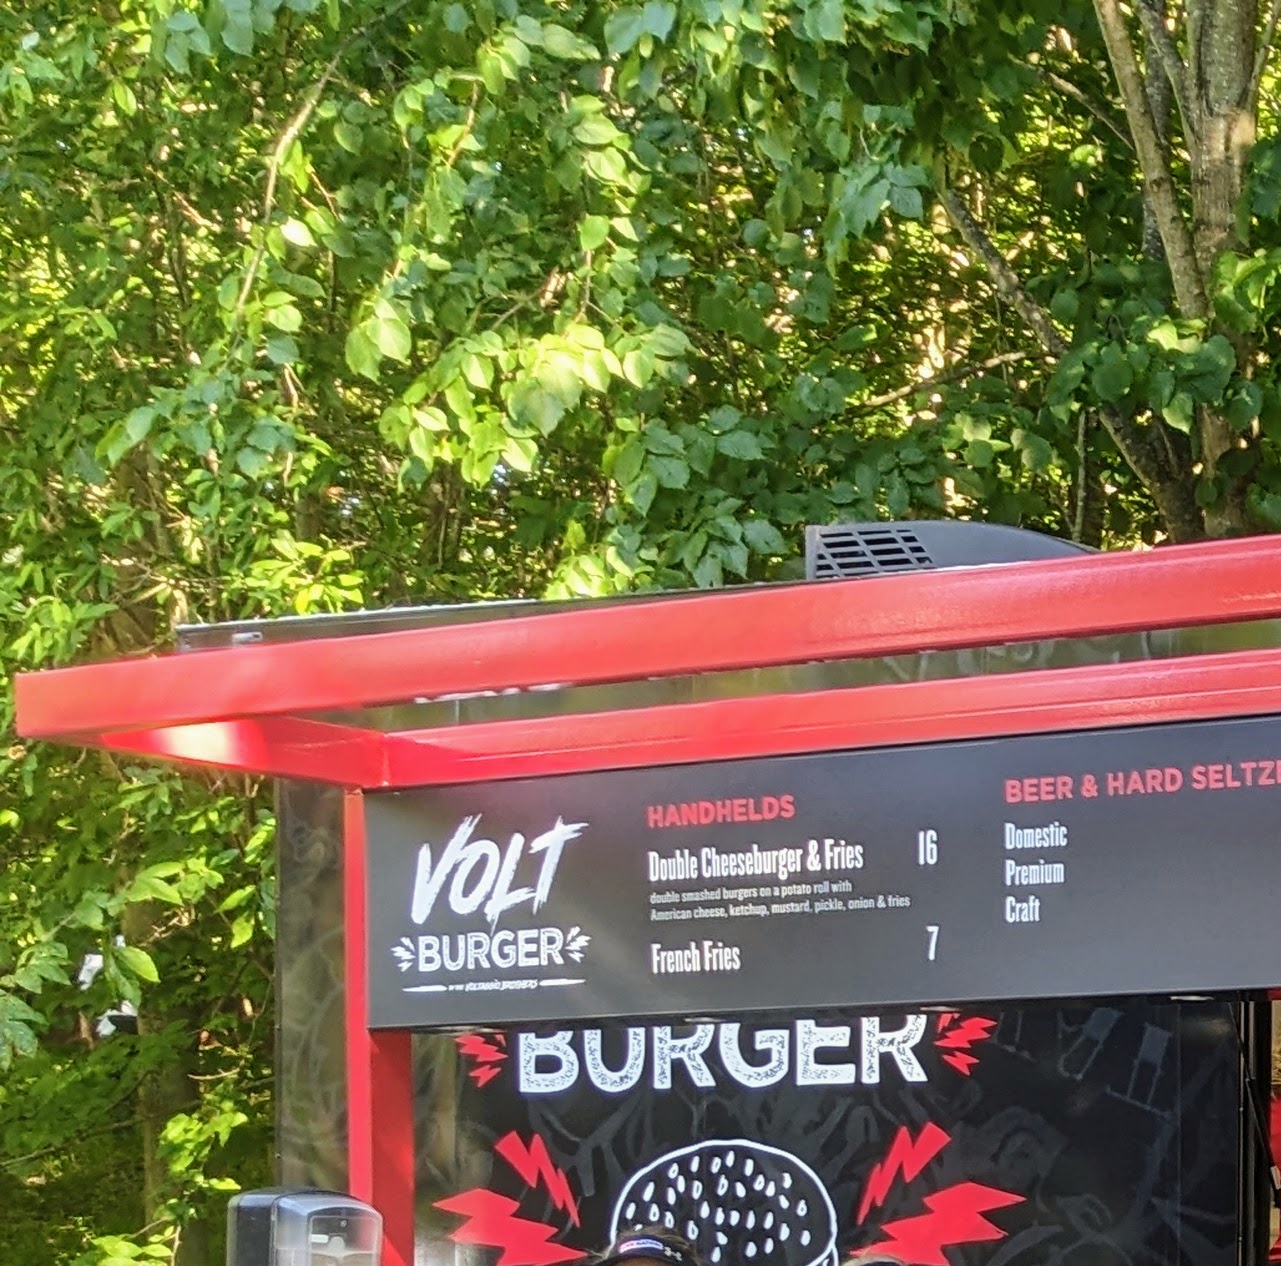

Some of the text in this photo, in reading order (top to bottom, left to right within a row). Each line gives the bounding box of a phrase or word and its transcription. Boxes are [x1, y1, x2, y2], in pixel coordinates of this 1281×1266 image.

[1004, 776, 1073, 803] BEER
[1080, 774, 1098, 799] &
[1106, 767, 1183, 796] HARD
[647, 796, 795, 828] HANDHELDS
[1004, 821, 1068, 851] Domestic
[648, 830, 938, 882] Double Cheeseburger & Fries 16
[1004, 858, 1065, 886] Premium
[410, 813, 590, 934] VOLT
[650, 880, 853, 904] double smashed burgers on a potato roll with
[650, 907, 692, 921] American
[693, 905, 728, 919] cheese,
[729, 903, 770, 917] ketchup,
[814, 896, 846, 913] pickle,
[848, 896, 875, 909] onion
[877, 895, 886, 908] &
[887, 894, 911, 907] fries
[1004, 895, 1041, 923] Craft
[418, 927, 565, 972] BURGER
[651, 926, 939, 974] French Fries 7
[518, 1014, 929, 1094] BURGER
